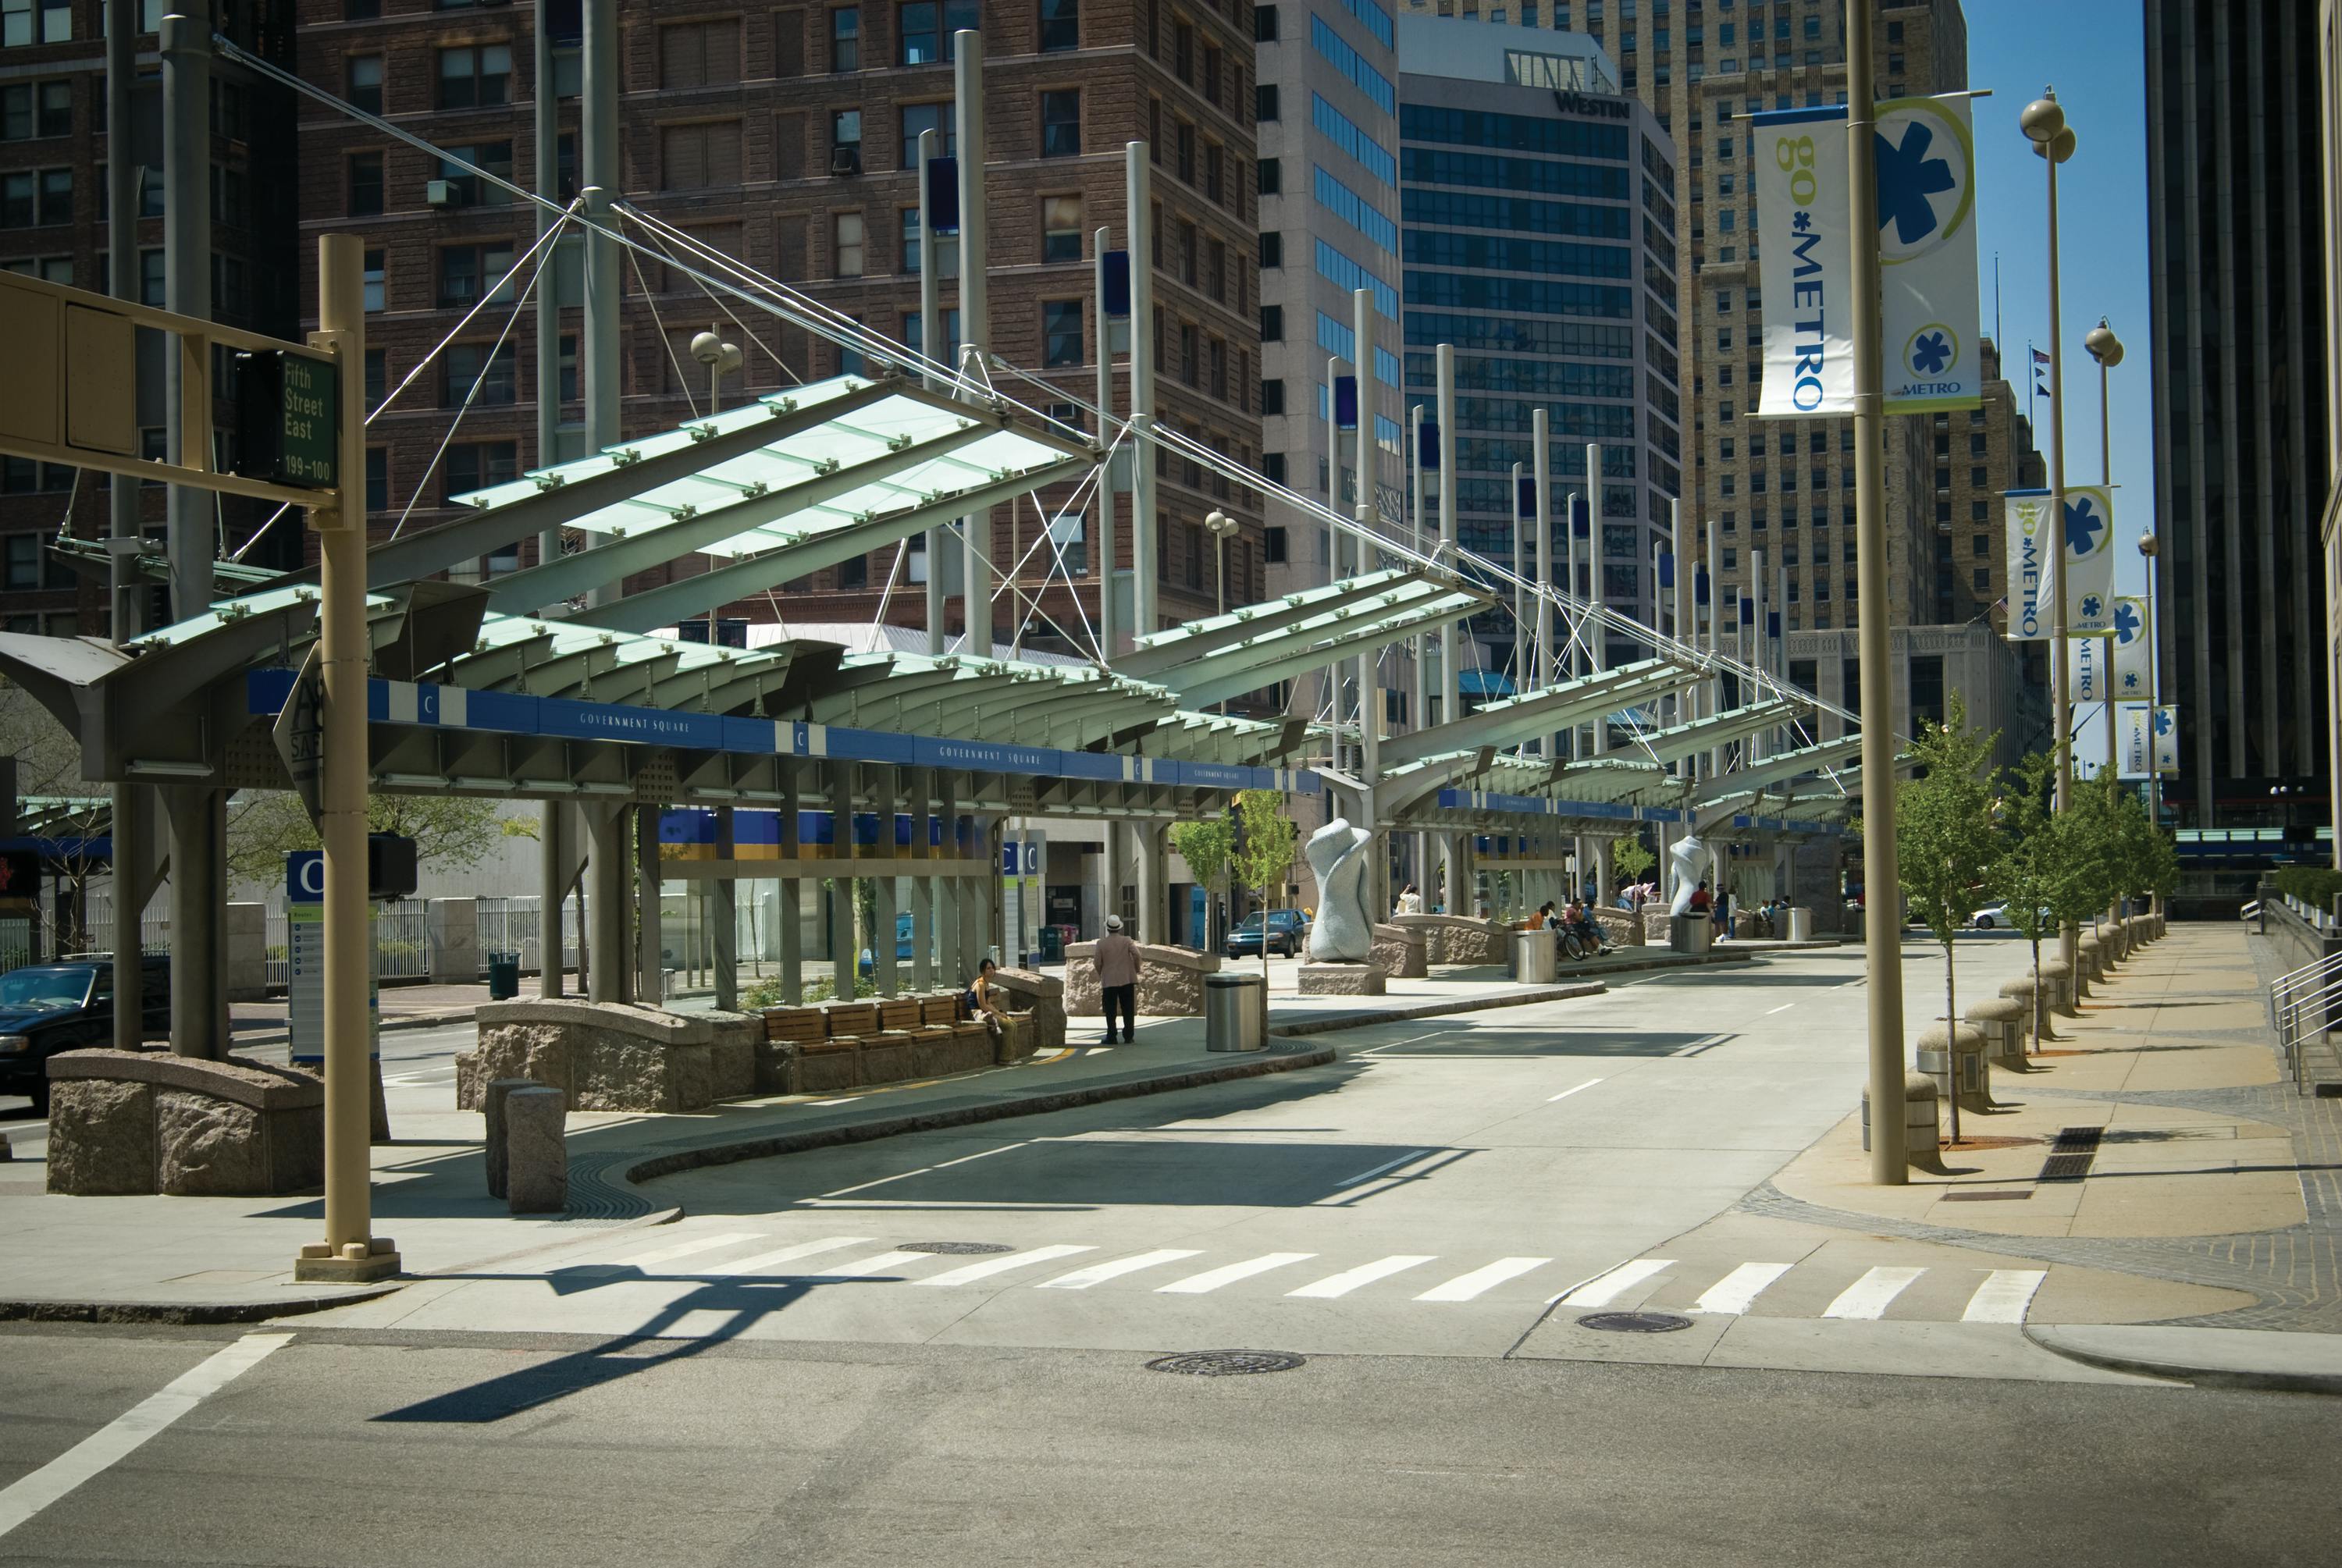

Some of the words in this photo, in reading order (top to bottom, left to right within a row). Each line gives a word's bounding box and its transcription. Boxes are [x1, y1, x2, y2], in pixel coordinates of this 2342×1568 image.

[1554, 91, 1630, 119] WESTIN
[285, 361, 311, 389] Fifth
[1902, 382, 1961, 396] METRO
[285, 388, 323, 418] Street
[285, 412, 312, 440] East
[286, 454, 330, 481] 199-100
[2023, 546, 2038, 638] METRO
[2076, 620, 2106, 629] METRO
[424, 695, 433, 713] C
[580, 713, 647, 729] GOVERNMENT
[653, 720, 689, 733] SQUARE
[798, 731, 804, 746] C
[939, 746, 1000, 761] GOVERNMENT
[1007, 752, 1041, 765] SQUARE
[1135, 763, 1141, 775] C
[1028, 847, 1036, 869] C
